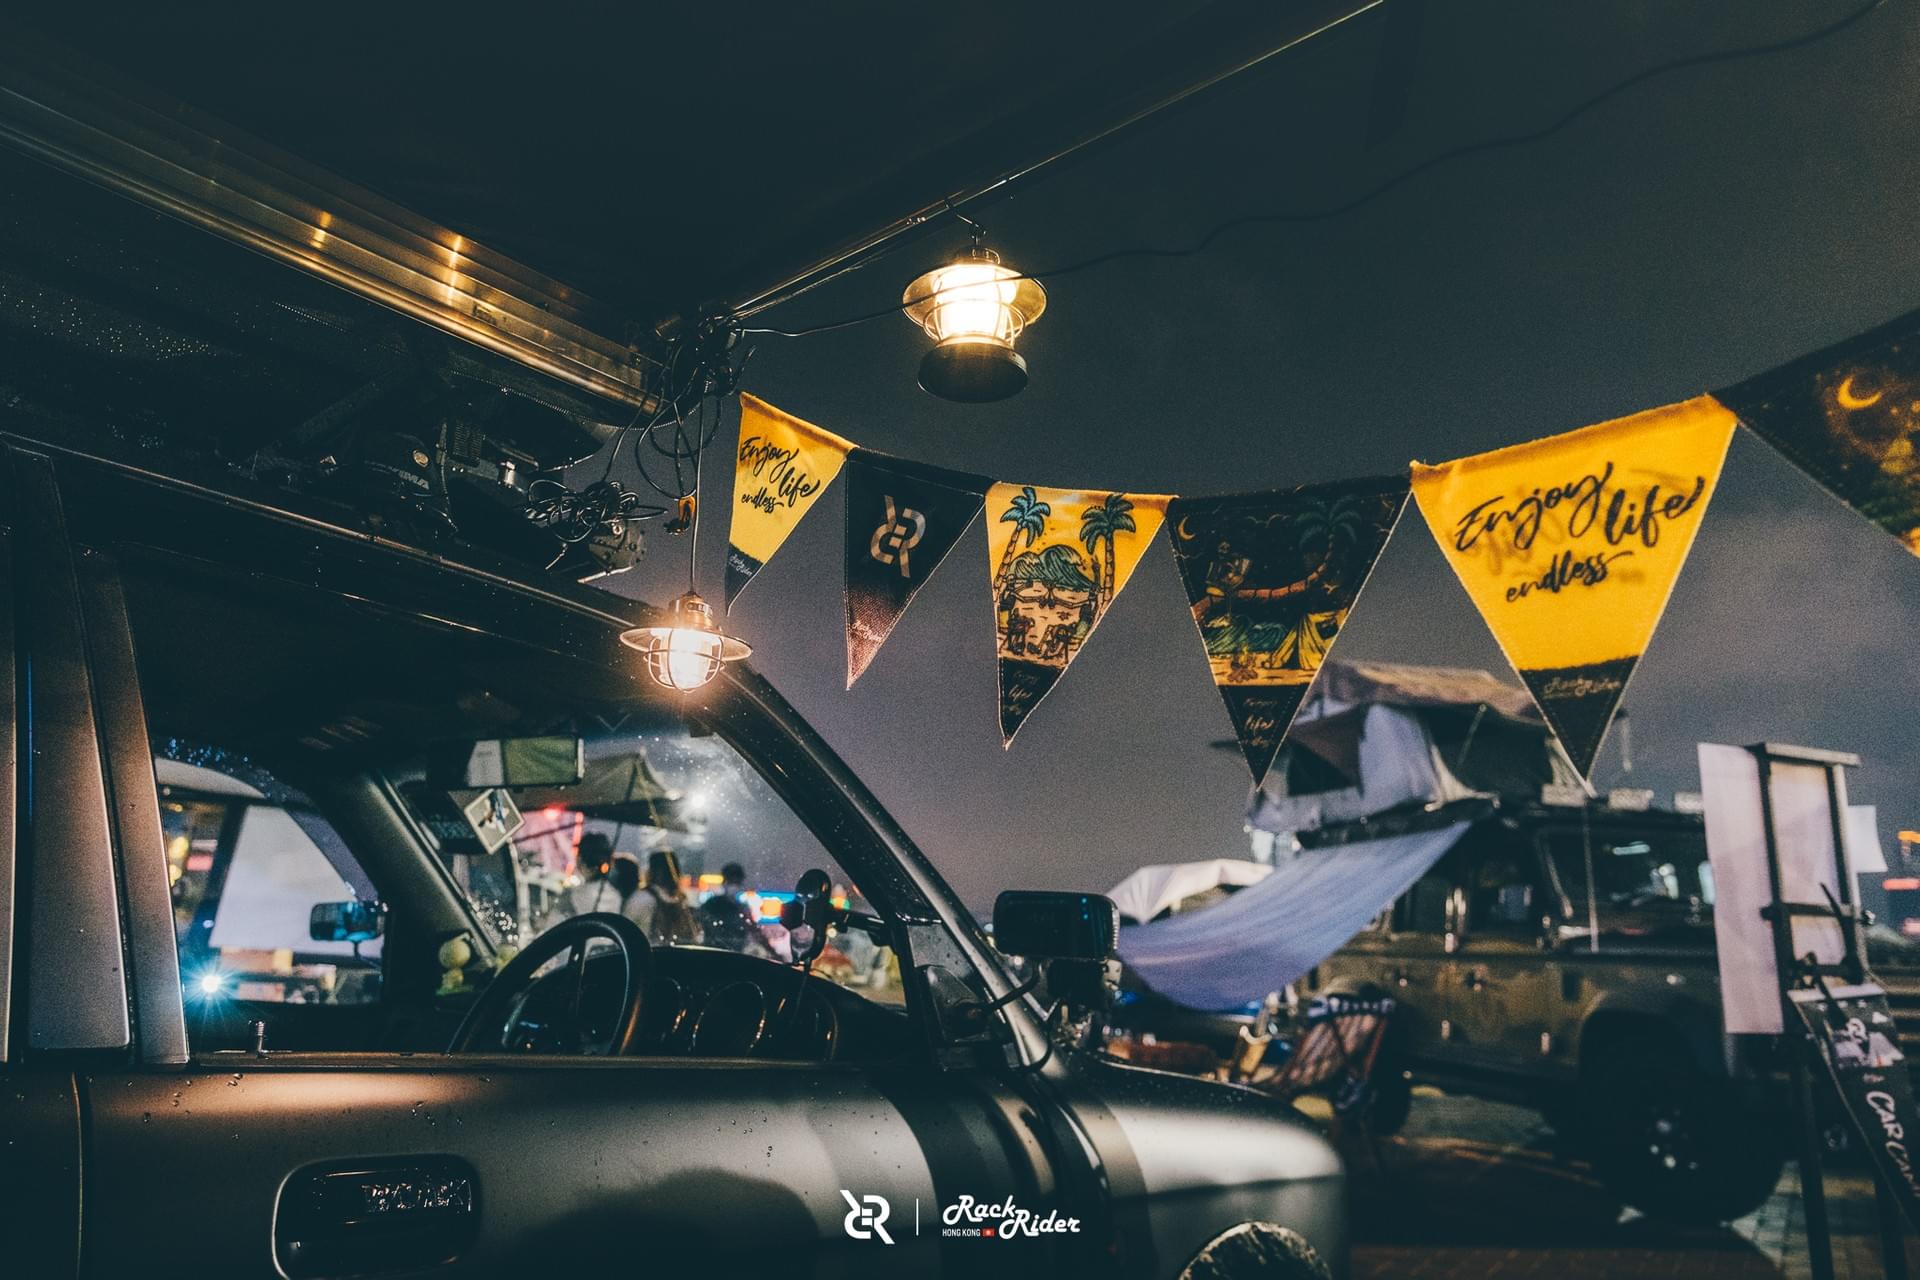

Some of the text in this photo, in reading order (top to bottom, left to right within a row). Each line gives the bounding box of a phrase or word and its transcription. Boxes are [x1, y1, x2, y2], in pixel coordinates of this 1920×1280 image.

[739, 436, 800, 484] Enjoy
[741, 486, 784, 514] endless
[777, 466, 821, 509] life
[1455, 461, 1614, 552] Enjoy
[1604, 475, 1706, 548] life
[1505, 550, 1634, 603] endless
[1865, 1090, 1904, 1140] CAR
